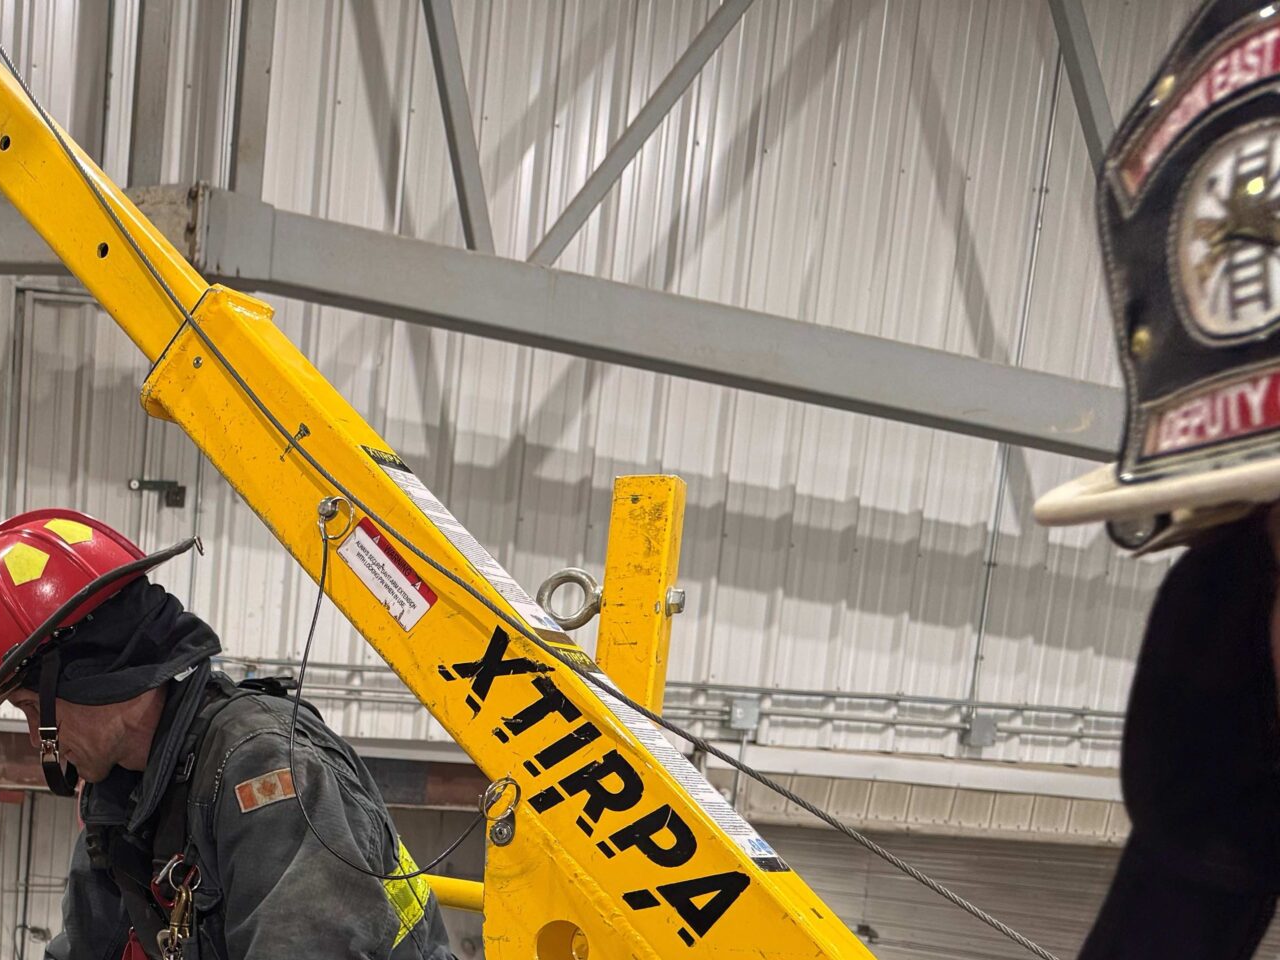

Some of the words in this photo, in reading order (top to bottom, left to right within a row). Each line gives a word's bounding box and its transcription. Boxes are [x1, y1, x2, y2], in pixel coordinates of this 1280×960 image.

[1158, 377, 1272, 451] DEPUTY
[355, 540, 370, 557] ALWAYS
[368, 553, 384, 571] SECURE
[396, 586, 417, 610] EXTENSION
[356, 552, 367, 564] WITH
[364, 560, 380, 581] LOCKING
[383, 582, 396, 597] WHEN
[383, 544, 412, 577] WARNING
[437, 624, 752, 948] XTIRPA
